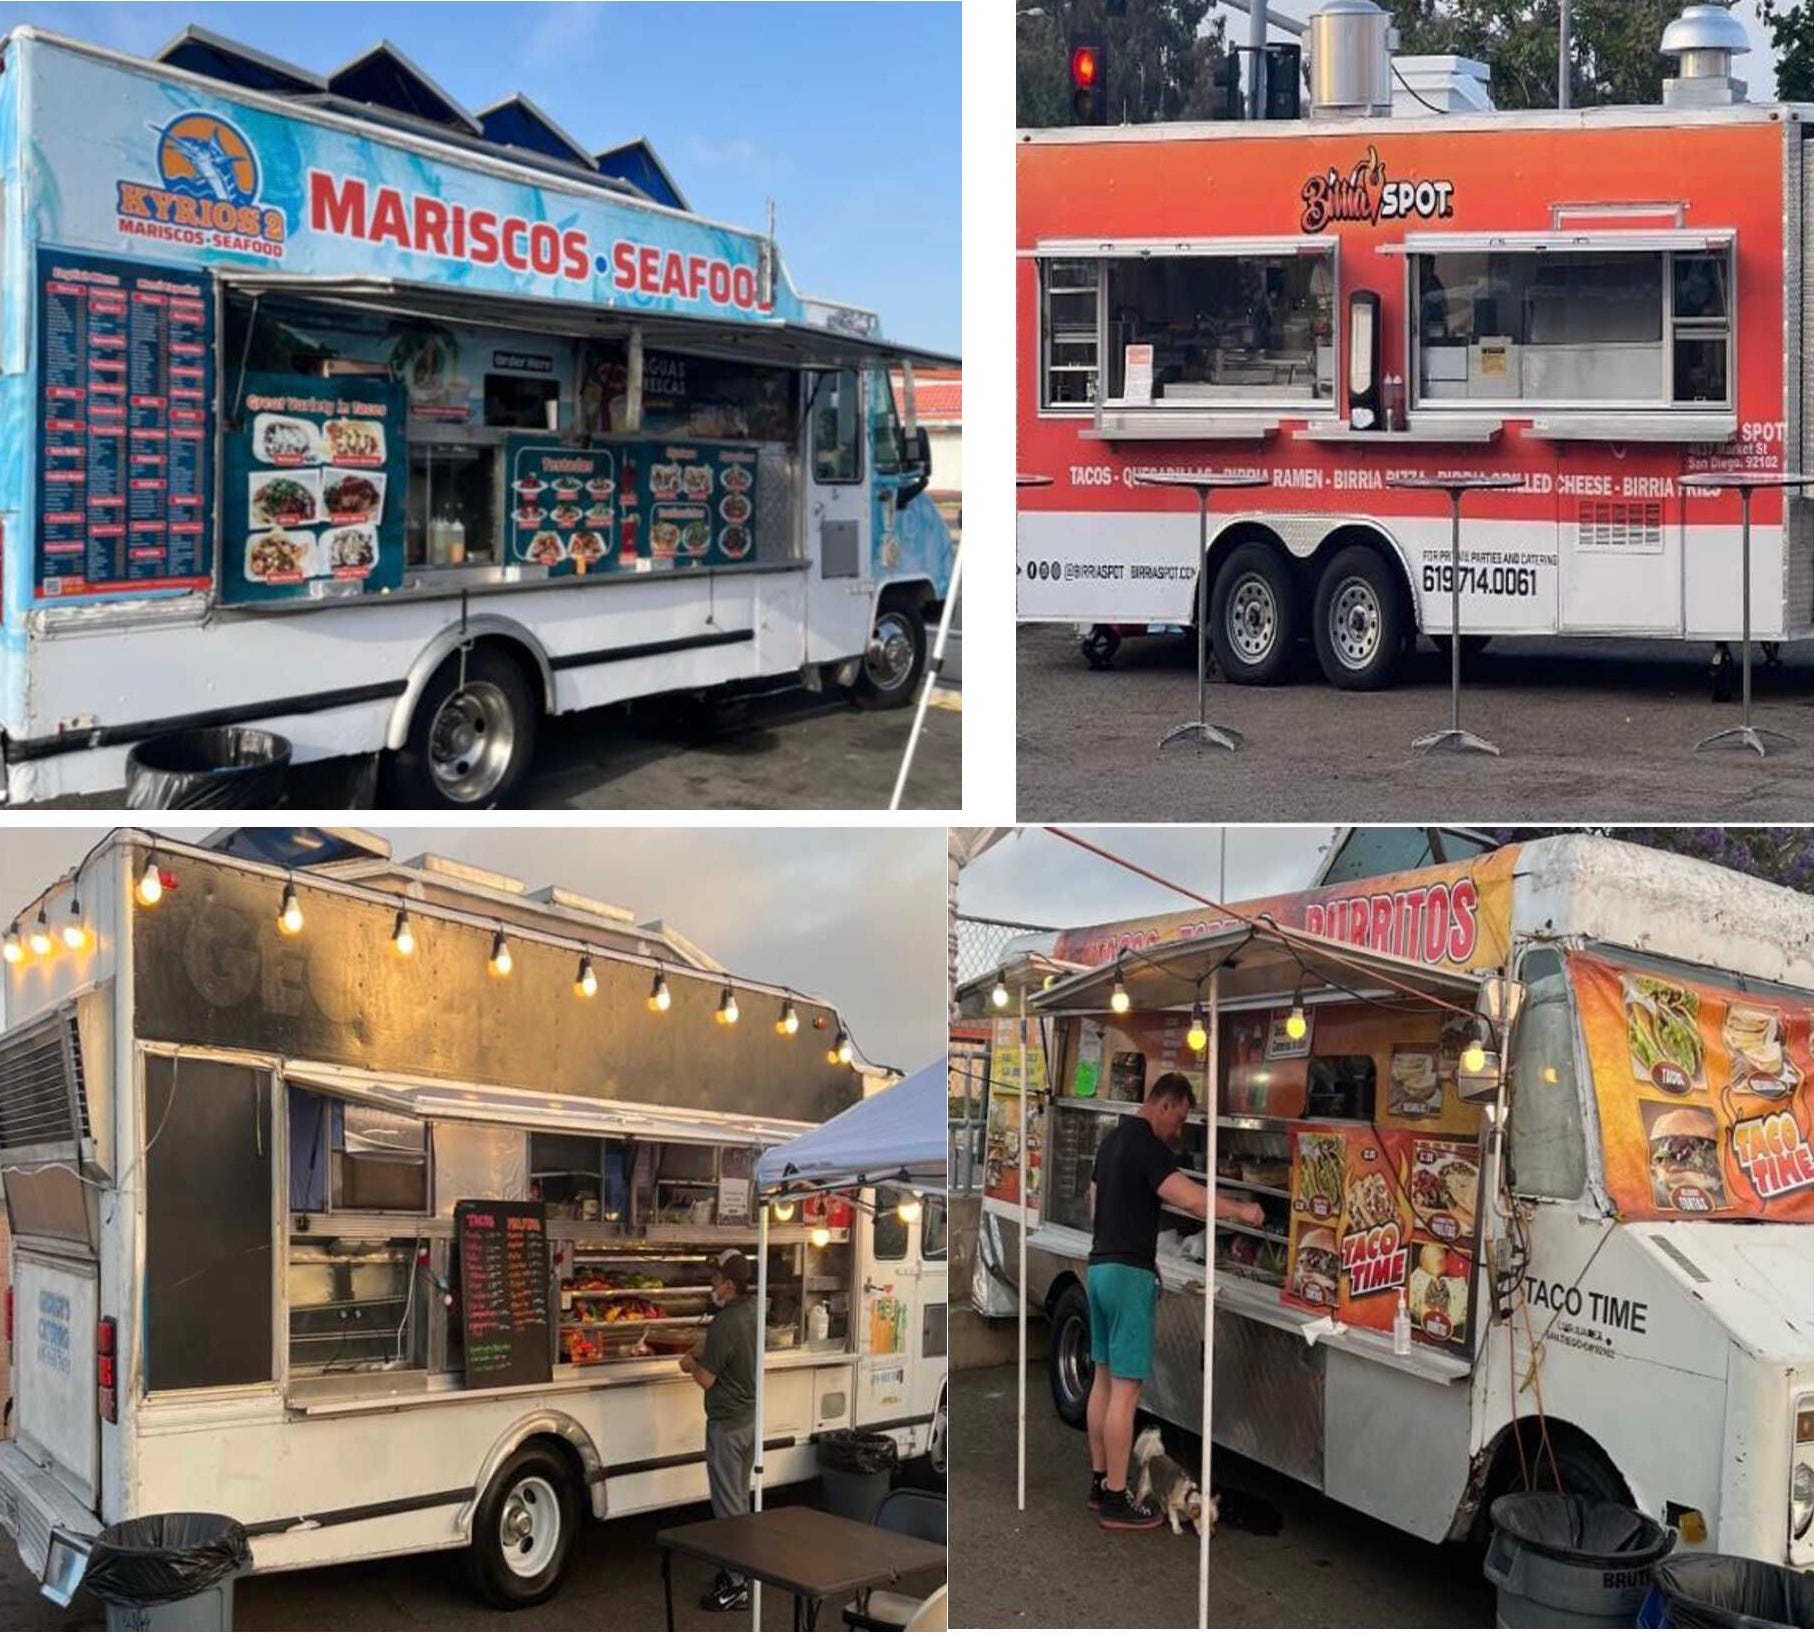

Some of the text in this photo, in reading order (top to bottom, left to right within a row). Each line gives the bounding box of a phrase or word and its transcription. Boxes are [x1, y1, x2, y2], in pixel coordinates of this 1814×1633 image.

[118, 181, 284, 241] KYRIOS 2
[1381, 180, 1454, 218] SPOT
[118, 219, 284, 258] MARISCOS SEAFOOD
[311, 170, 773, 312] MARISCOS SEAFOO
[1742, 421, 1786, 442] SPOT
[1756, 443, 1768, 454] St
[1069, 466, 1112, 485] TACOS
[1273, 468, 1323, 488] RAMEN
[1333, 469, 1383, 490] BIRRIA
[1557, 474, 1612, 495] CHEESE
[1622, 476, 1675, 498] BIRRIA
[1688, 457, 1708, 469] San
[1745, 456, 1778, 468] 92102
[1423, 550, 1557, 566] FOR PRIATE PARTIES AND CATERING
[1423, 565, 1536, 595] 619714.0061
[1306, 879, 1477, 964] BURRITOS
[1733, 1111, 1801, 1167] TACO
[1751, 1142, 1814, 1197] TIME
[1342, 1222, 1400, 1269] TACO
[1350, 1249, 1408, 1296] TIME
[1525, 1276, 1648, 1334] TACO TIME
